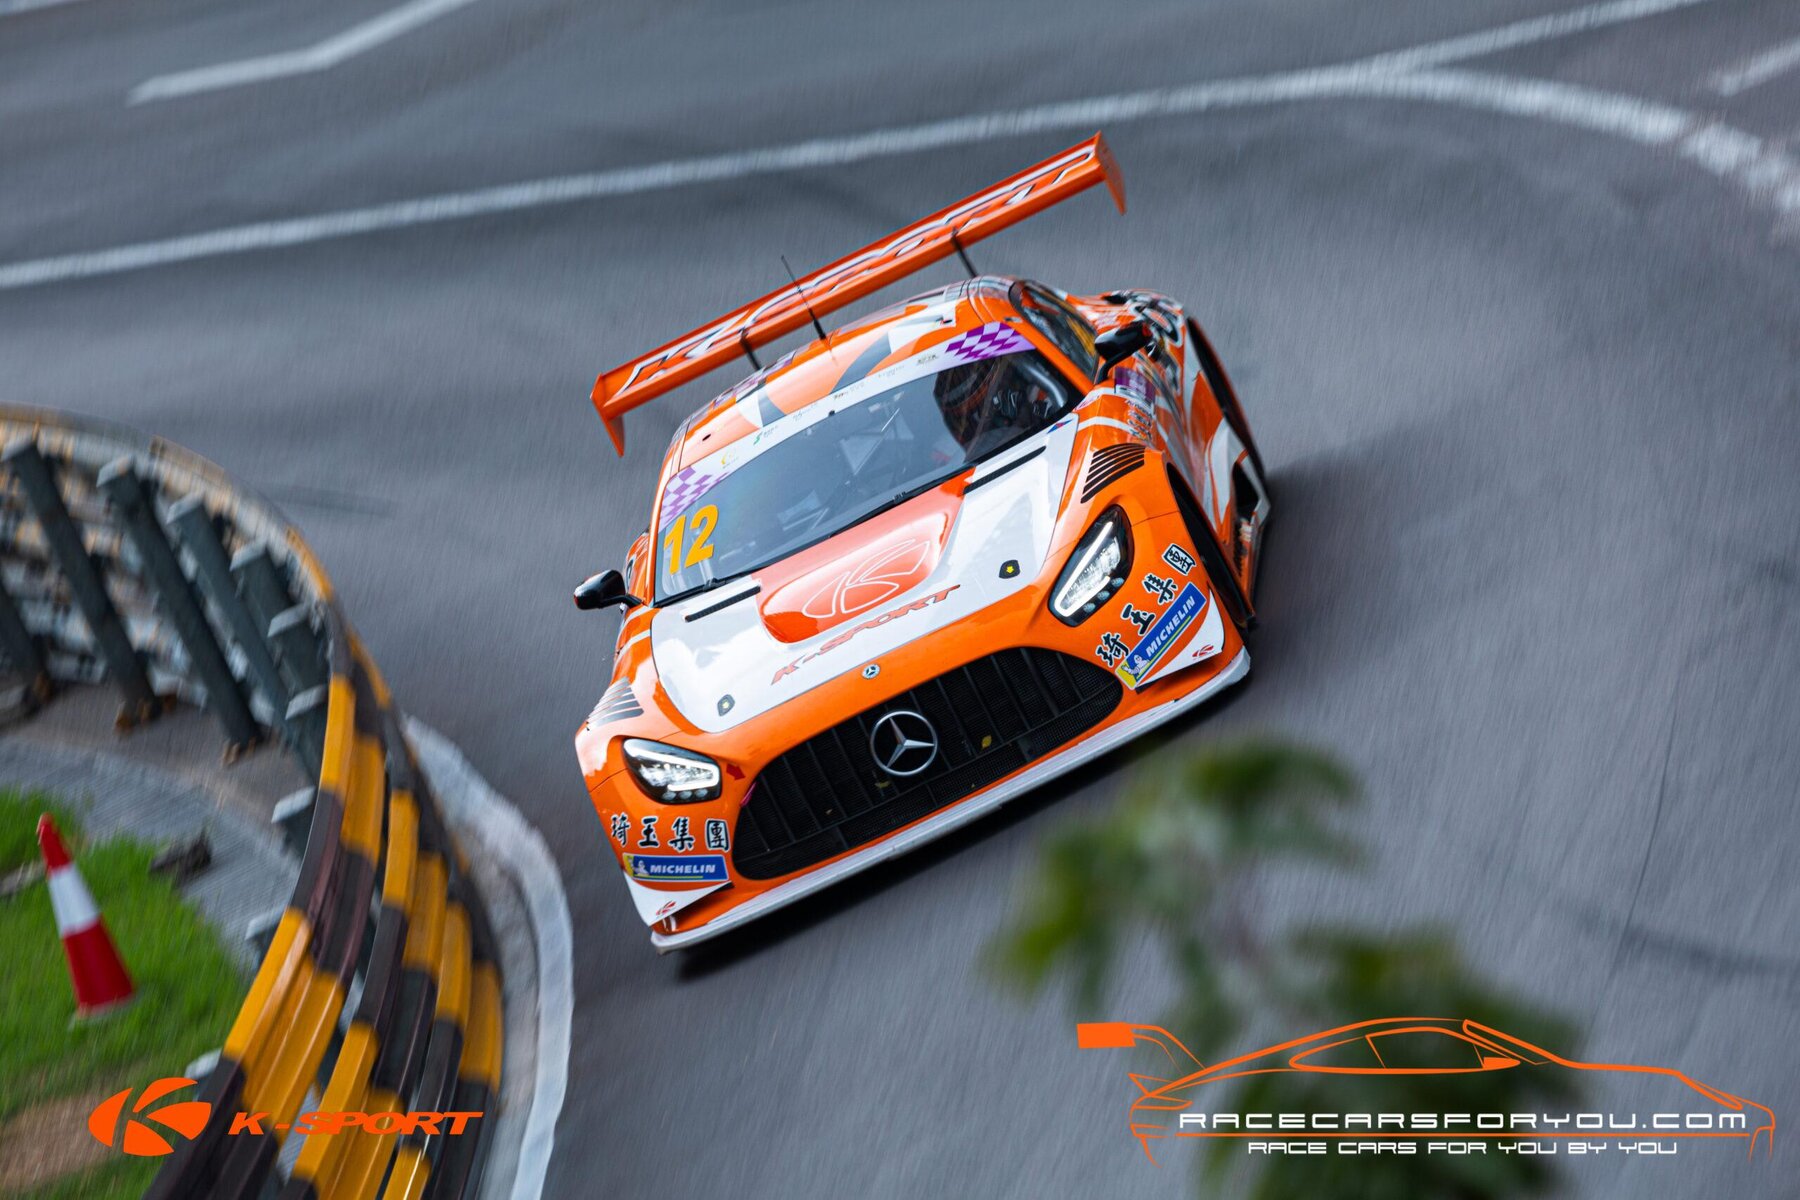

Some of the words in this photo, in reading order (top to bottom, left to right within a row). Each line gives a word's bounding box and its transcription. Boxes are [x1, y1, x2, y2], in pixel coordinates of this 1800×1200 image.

[664, 504, 719, 575] 12
[771, 584, 961, 686] K-SPORT
[1145, 595, 1196, 657] MICHELIN
[649, 863, 716, 875] MICHELIN
